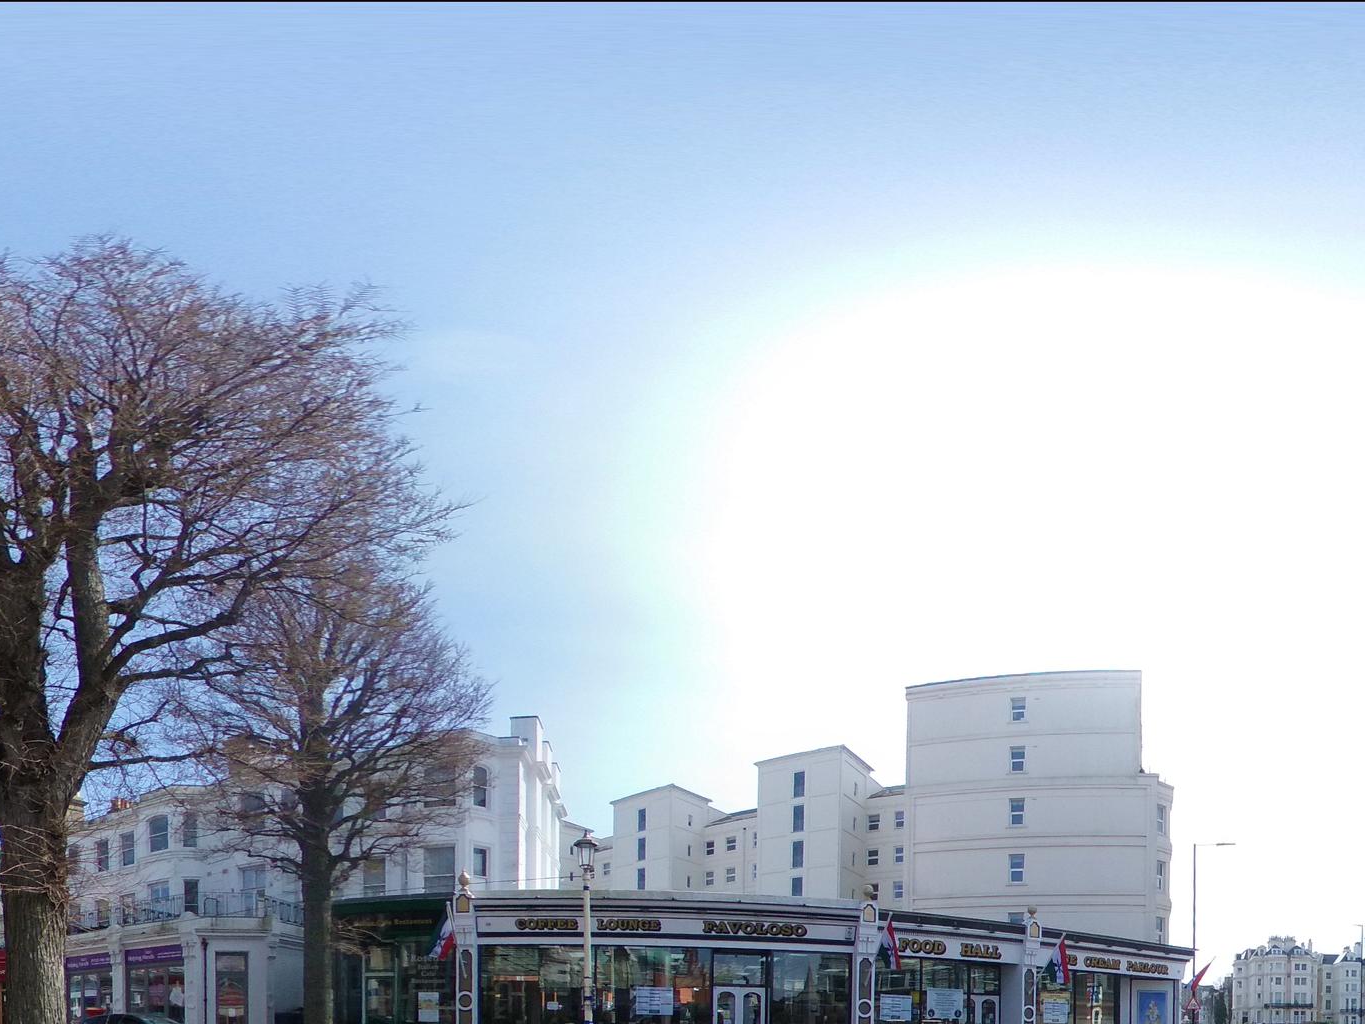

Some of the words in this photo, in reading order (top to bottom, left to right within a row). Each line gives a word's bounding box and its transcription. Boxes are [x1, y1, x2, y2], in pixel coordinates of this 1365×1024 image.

[515, 918, 578, 930] COFFEE
[597, 919, 661, 931] LOUNGE
[702, 920, 807, 937] FAVOLOSO
[898, 938, 946, 955] FOOD
[960, 943, 1002, 960] HALL
[1084, 956, 1121, 970] CREAM
[1126, 960, 1169, 975] PARLOUR
